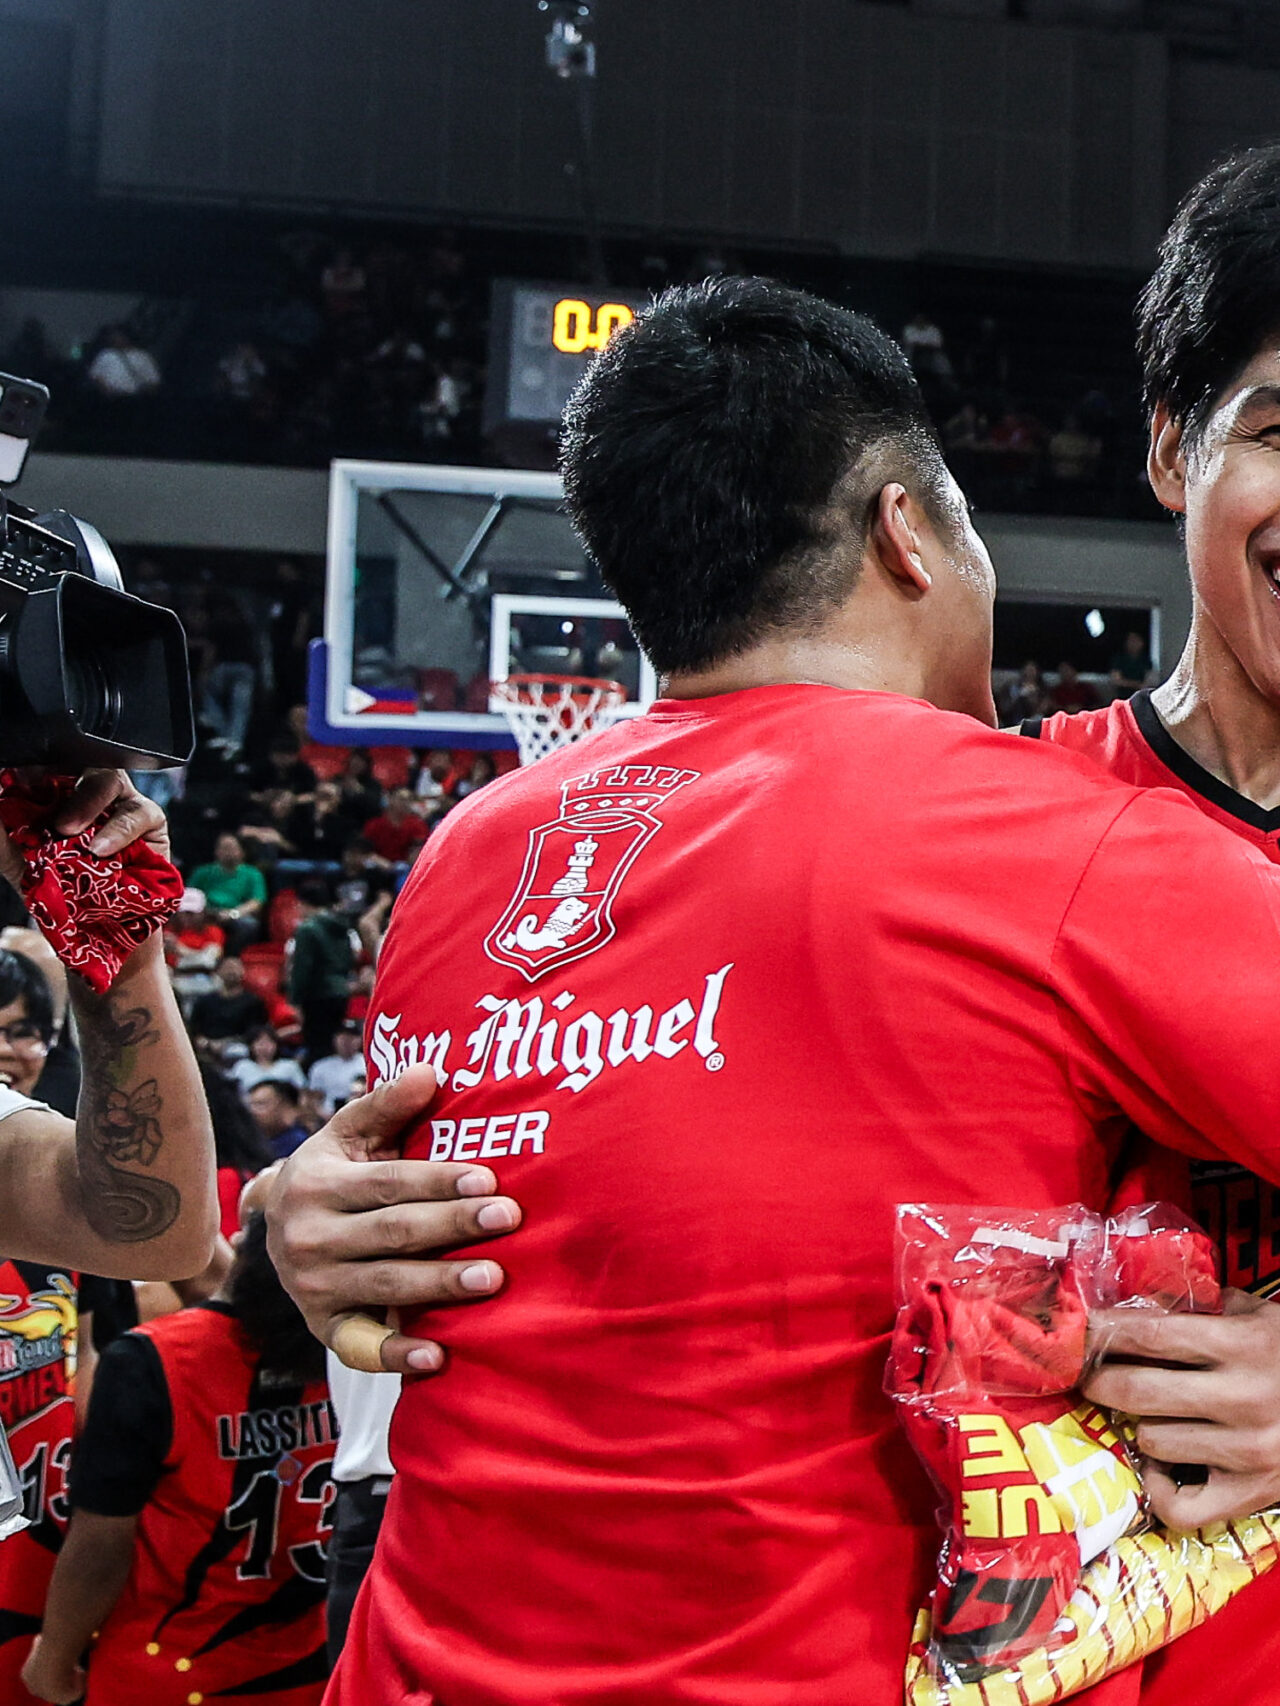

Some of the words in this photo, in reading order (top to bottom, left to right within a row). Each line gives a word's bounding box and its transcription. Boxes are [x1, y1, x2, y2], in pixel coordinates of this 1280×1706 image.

[369, 1011, 452, 1090] San
[452, 962, 735, 1094] Miguel
[429, 1109, 551, 1162] BEER
[18, 1437, 73, 1527] 13
[224, 1457, 338, 1584] 13
